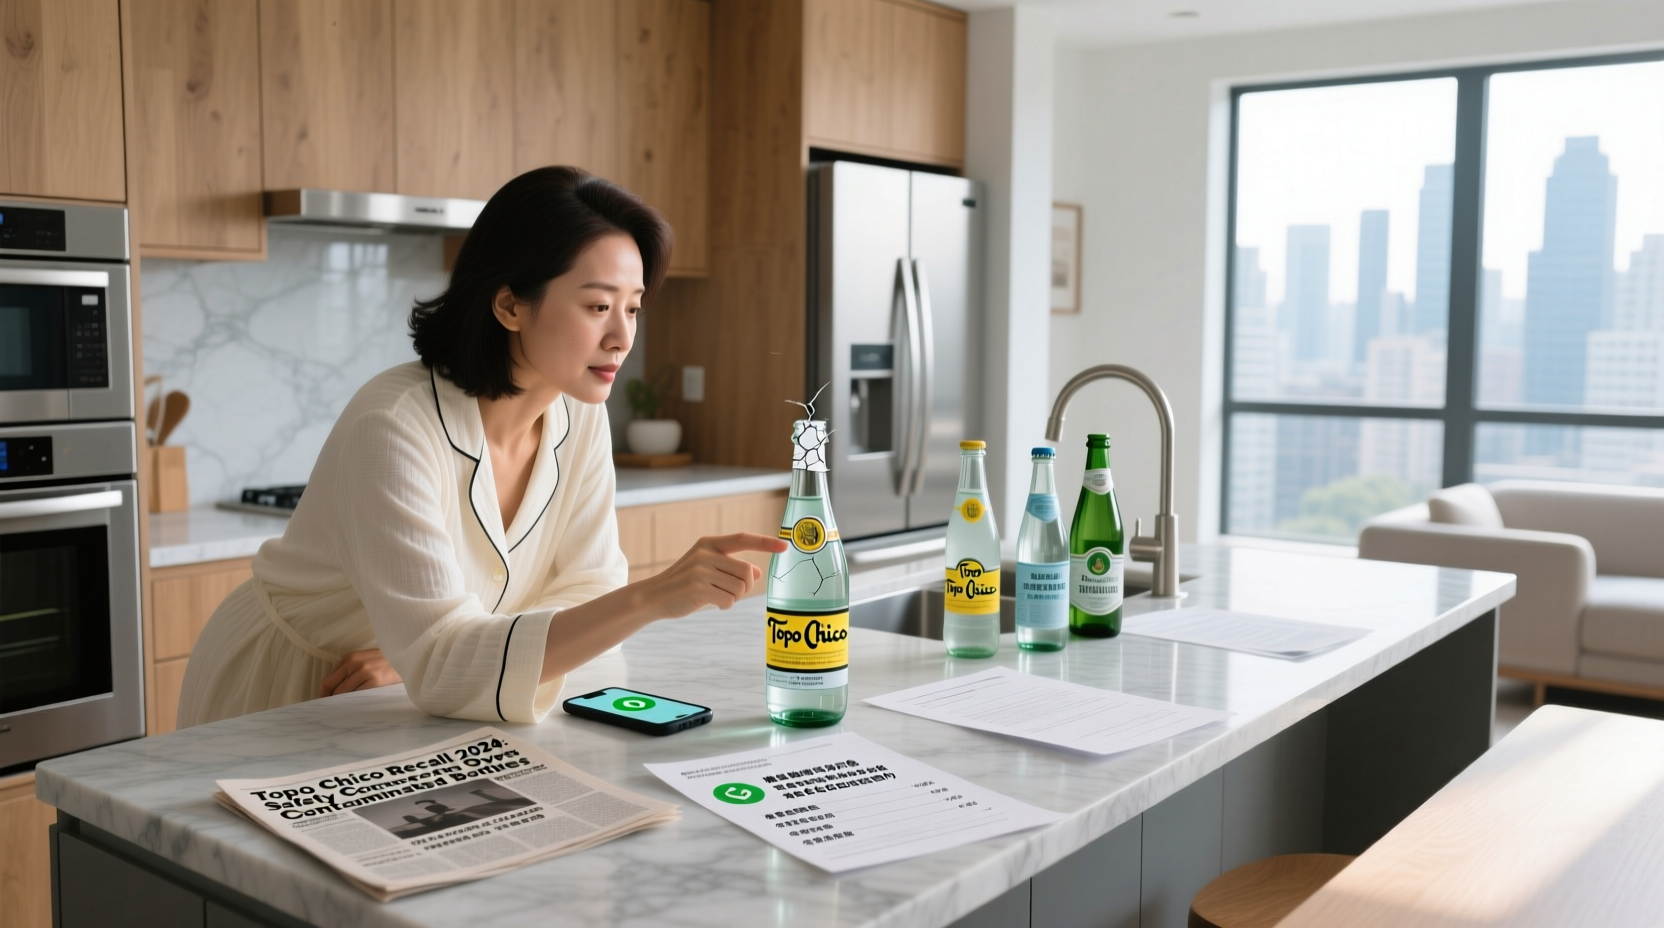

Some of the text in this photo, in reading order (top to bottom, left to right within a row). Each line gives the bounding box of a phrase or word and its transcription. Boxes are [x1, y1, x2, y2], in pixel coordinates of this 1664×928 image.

[768, 616, 848, 649] Topo Chico
[250, 786, 316, 801] Topo
[319, 771, 384, 789] Chico
[385, 752, 454, 776] Recall
